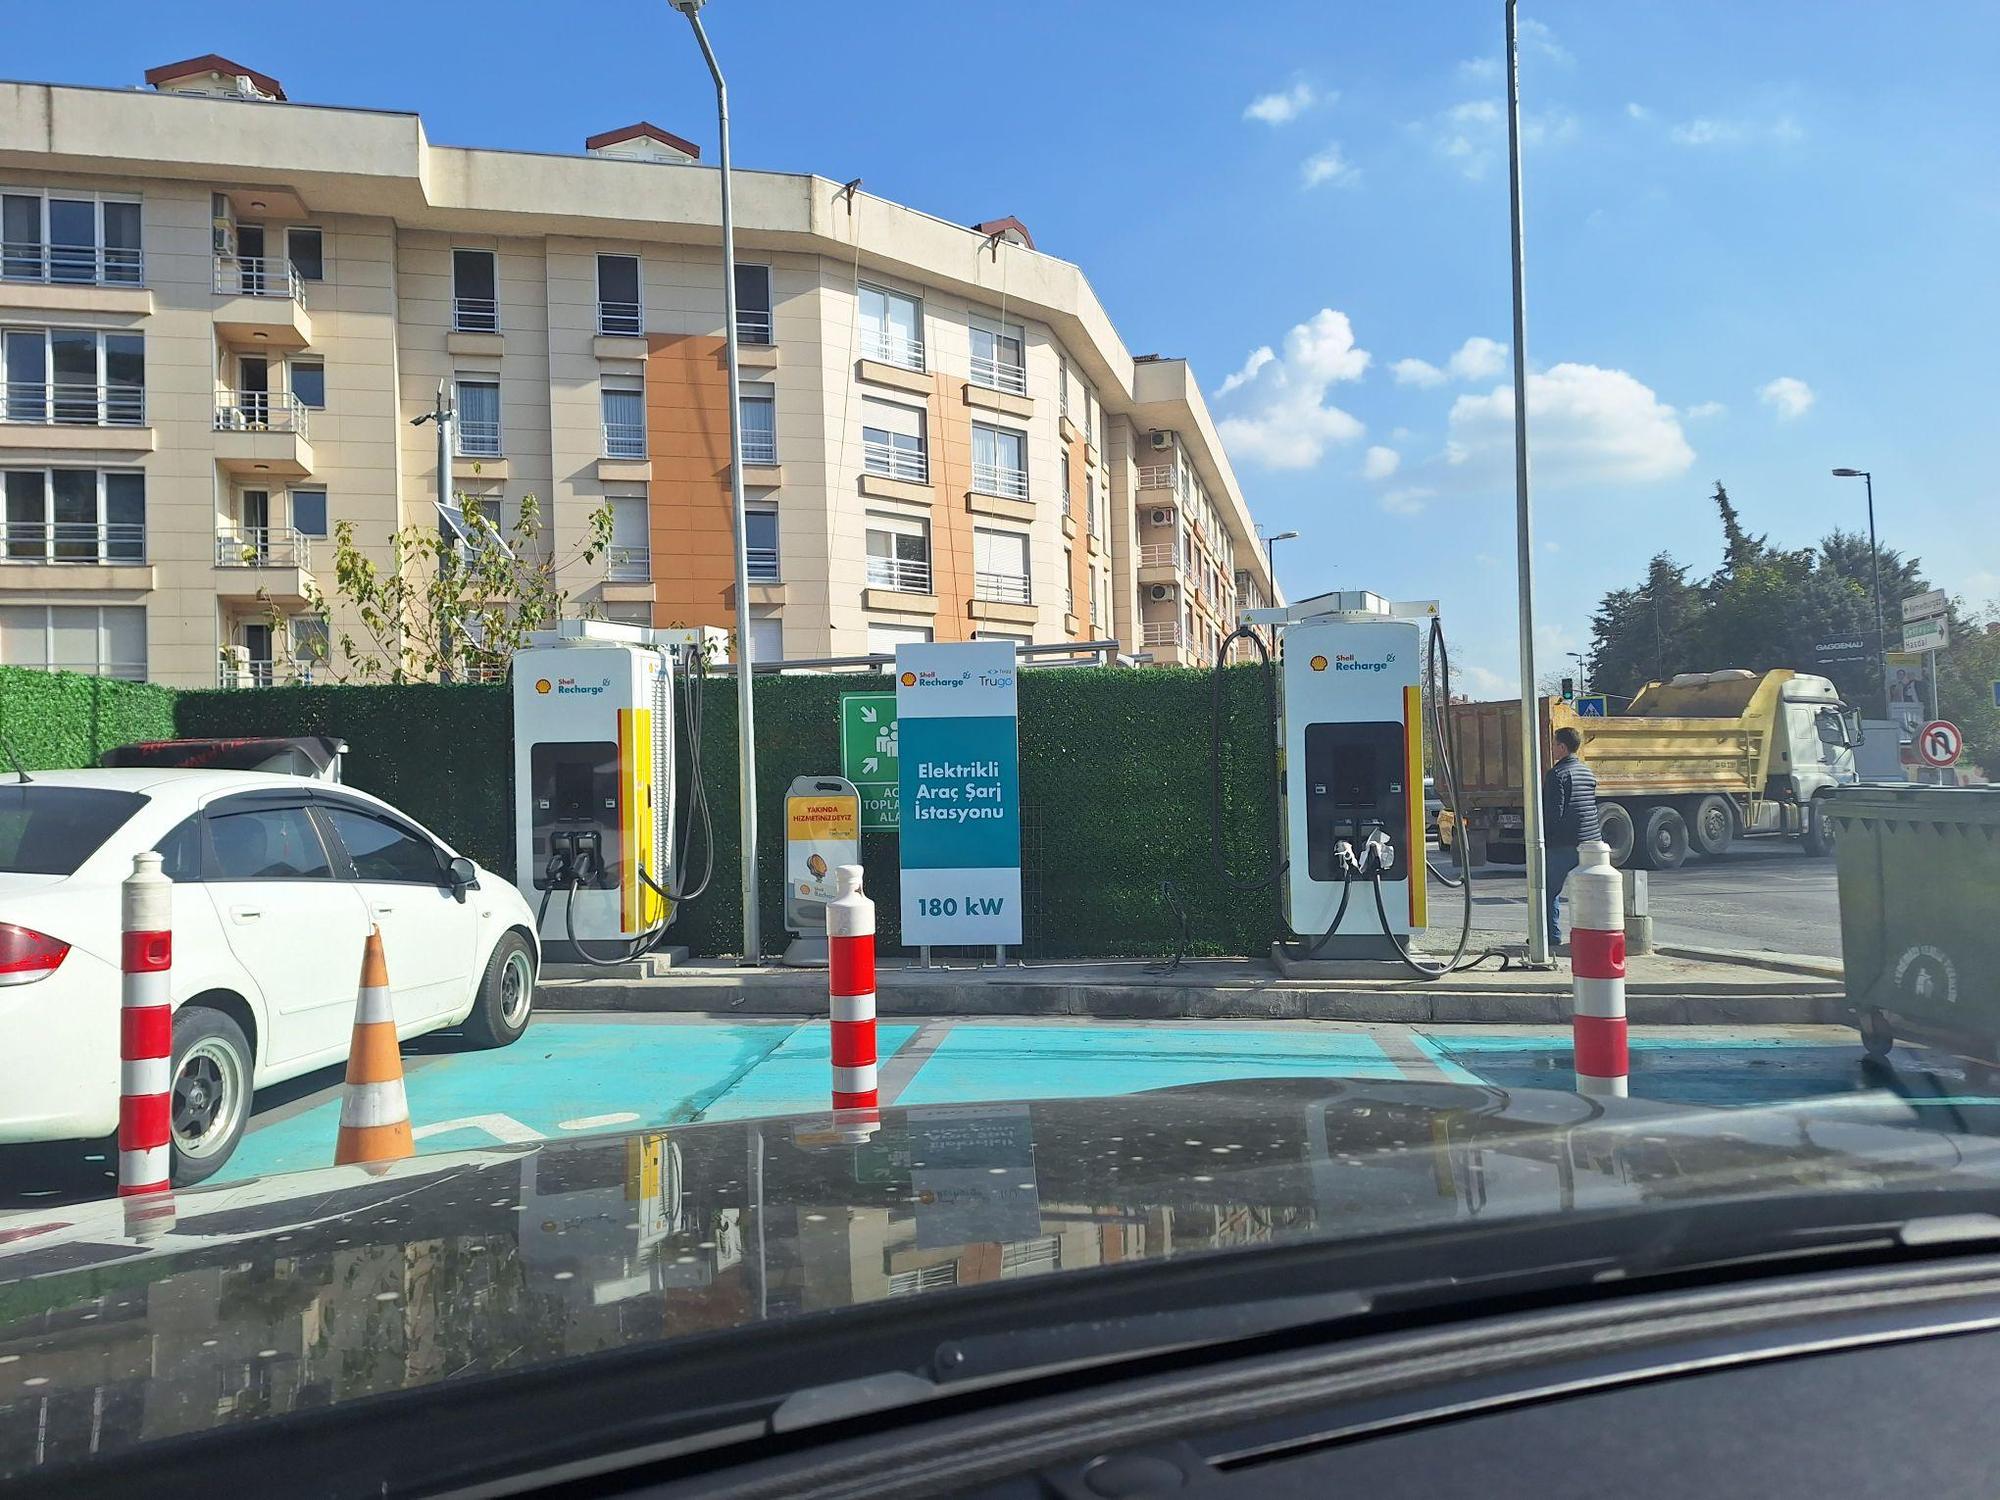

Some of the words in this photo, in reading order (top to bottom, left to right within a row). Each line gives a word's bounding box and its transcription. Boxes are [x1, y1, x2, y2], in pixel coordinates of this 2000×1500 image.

[1336, 661, 1387, 672] Recharge
[919, 678, 963, 687] Recharge
[979, 676, 1013, 688] Trugo
[558, 685, 603, 695] Recharge
[918, 762, 999, 778] Elektrikli
[916, 784, 959, 802] Araç
[965, 782, 1001, 802] Şarj
[915, 800, 1004, 823] İstasyonu
[918, 897, 957, 916] 180
[965, 896, 1004, 916] kW
